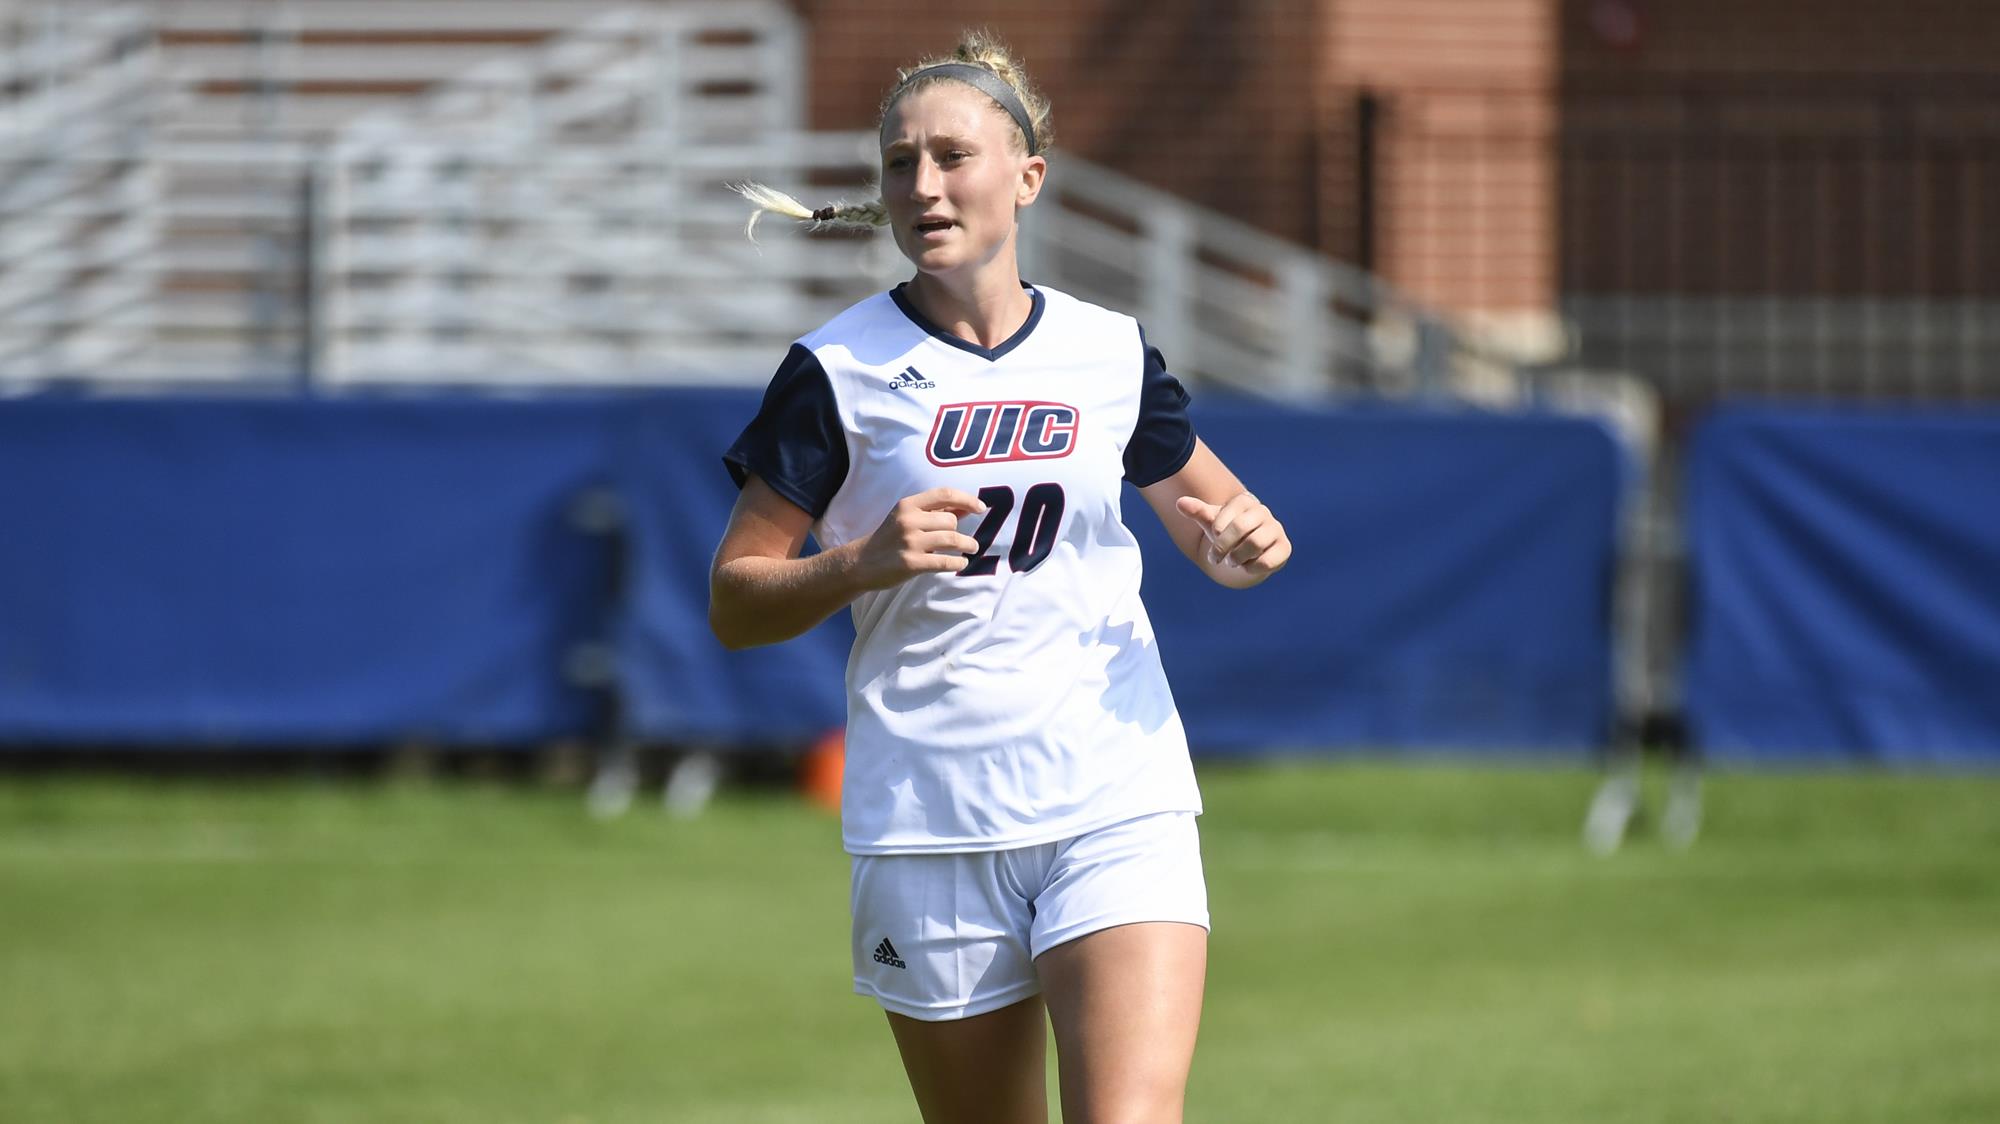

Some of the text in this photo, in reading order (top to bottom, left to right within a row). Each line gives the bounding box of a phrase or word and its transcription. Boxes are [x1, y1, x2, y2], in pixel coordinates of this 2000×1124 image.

[889, 379, 936, 390] adidas
[929, 403, 1076, 464] UIC
[955, 483, 1065, 577] 20
[873, 953, 906, 969] adidas
